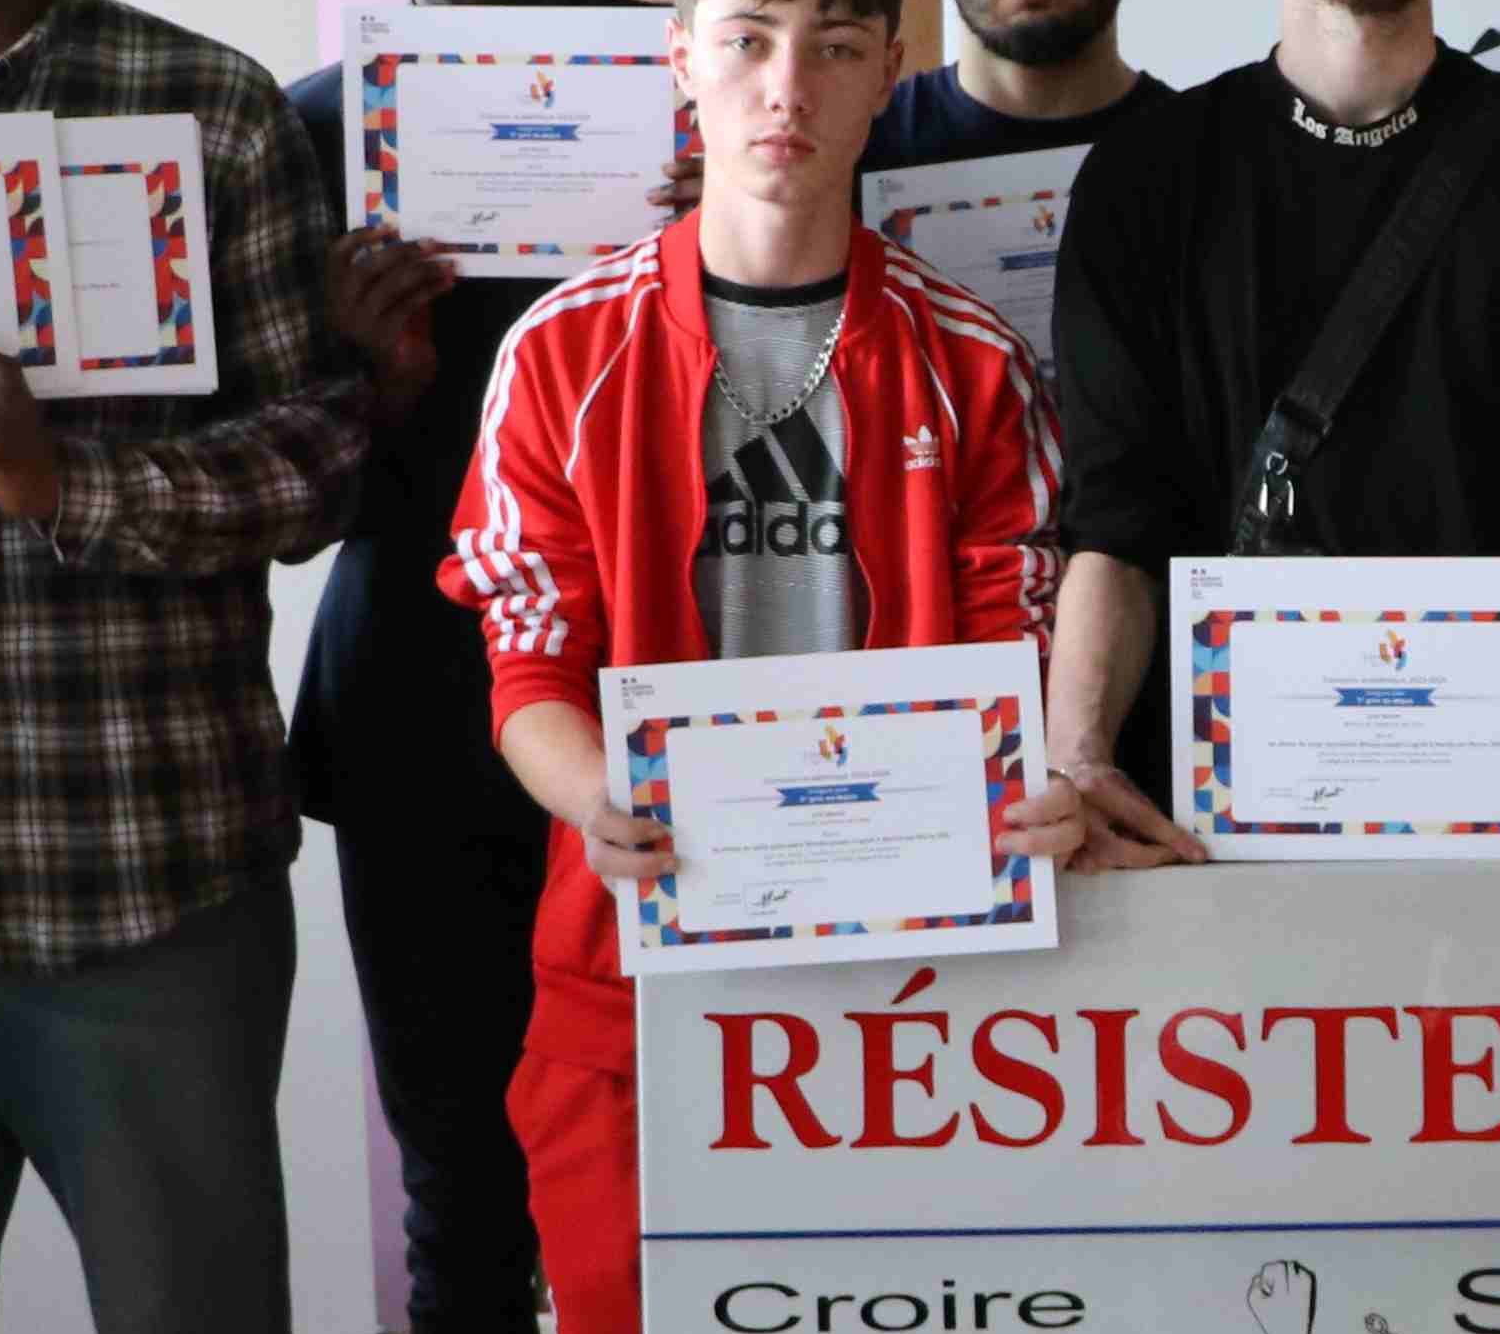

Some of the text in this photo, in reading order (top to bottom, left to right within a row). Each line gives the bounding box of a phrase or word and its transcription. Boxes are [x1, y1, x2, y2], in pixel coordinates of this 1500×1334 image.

[1291, 97, 1418, 147] Los Angeles
[712, 1278, 1088, 1334] Croire
